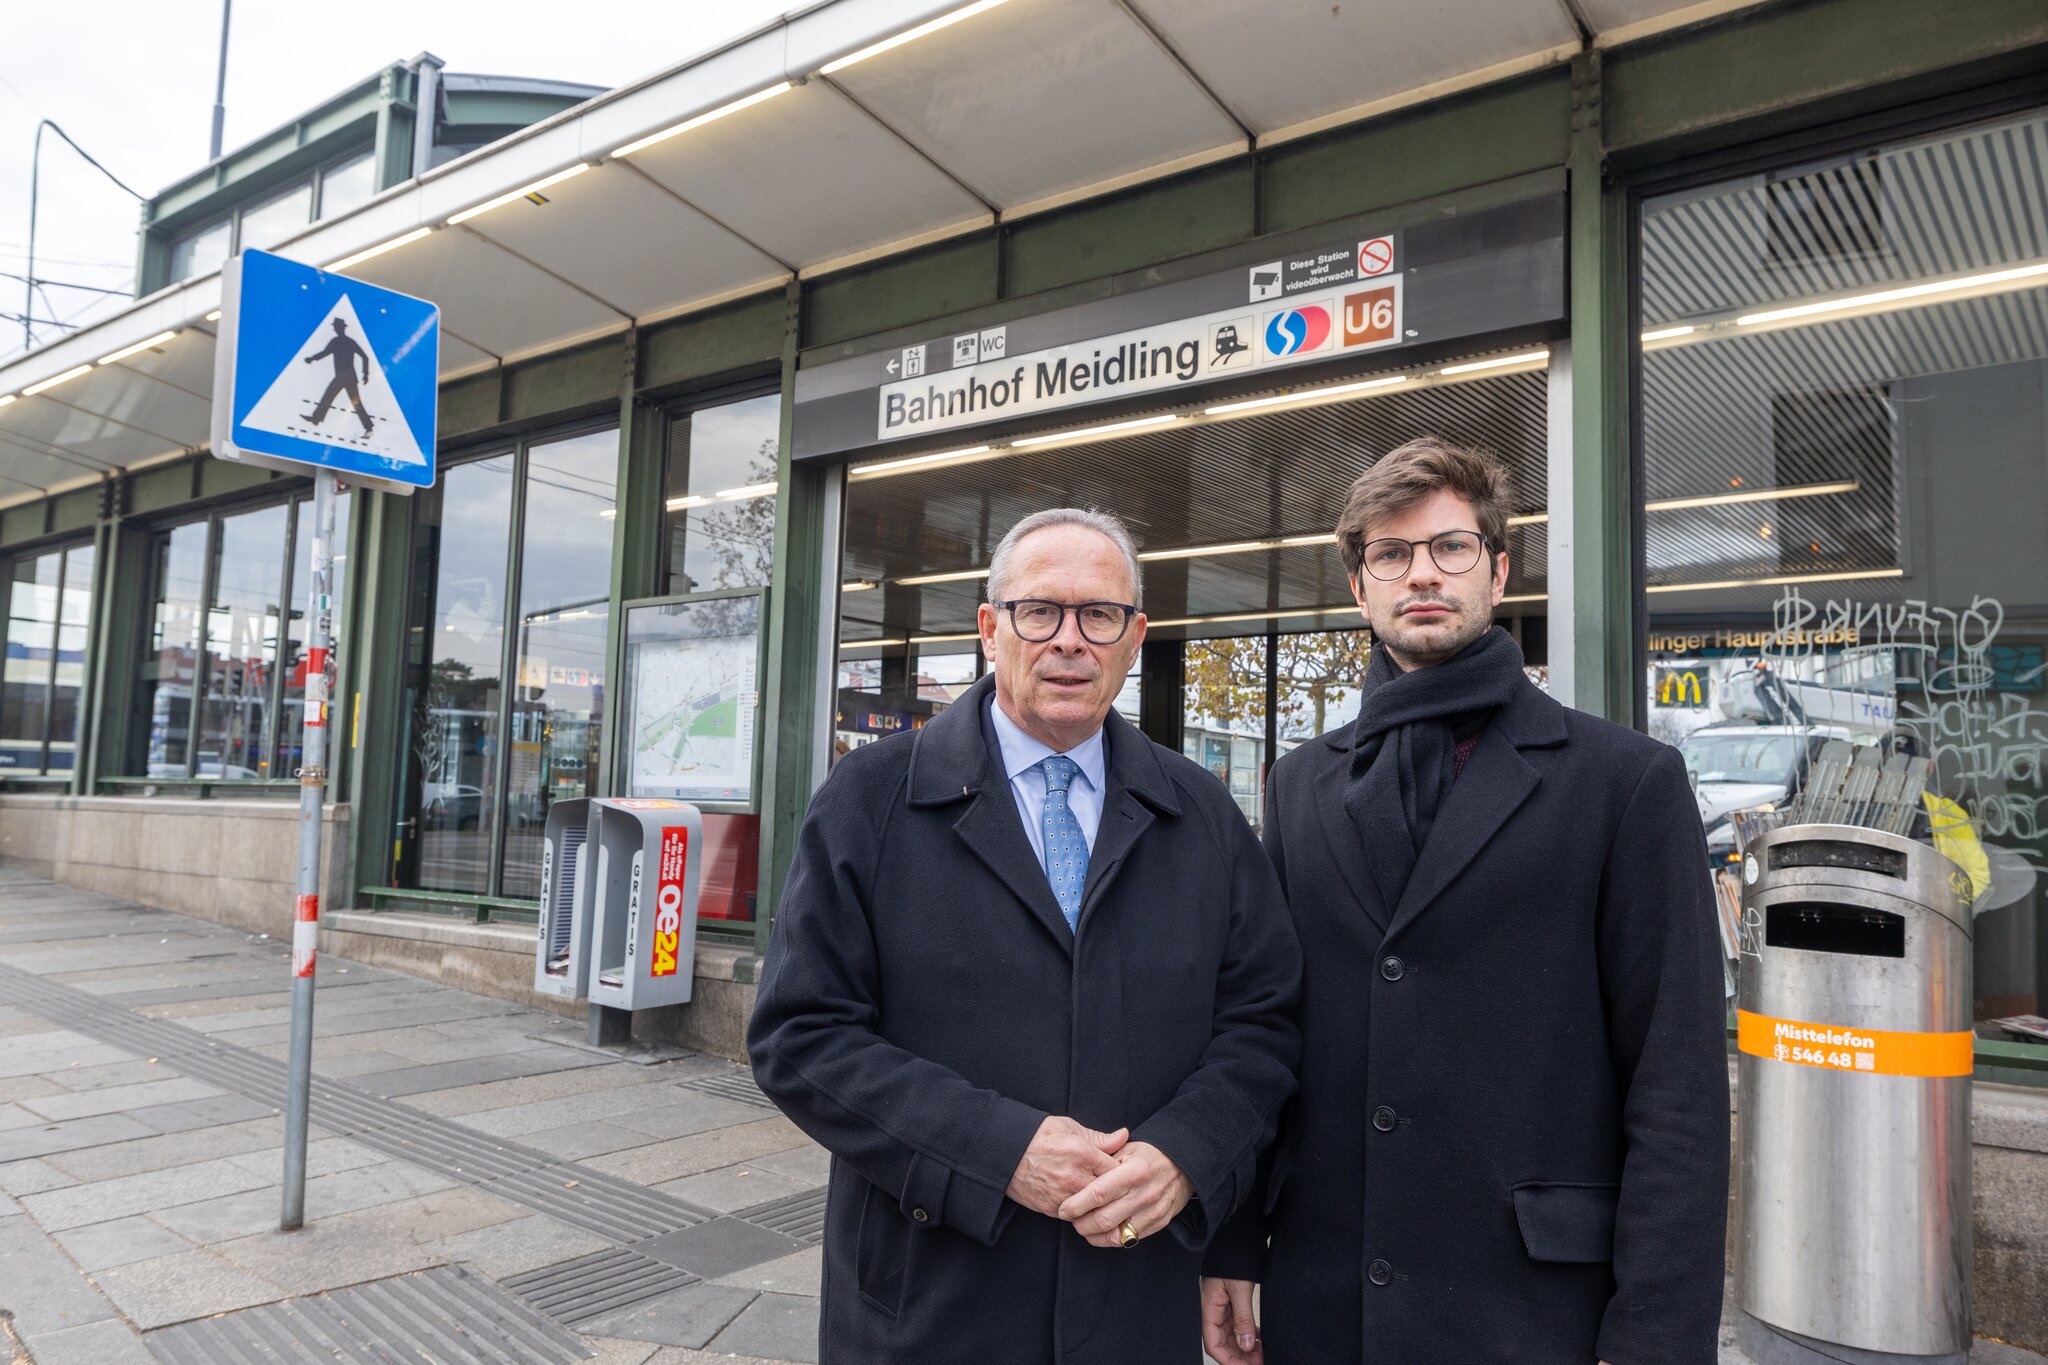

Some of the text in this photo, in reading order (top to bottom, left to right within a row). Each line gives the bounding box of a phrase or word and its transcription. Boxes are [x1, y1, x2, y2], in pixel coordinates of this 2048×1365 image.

[1290, 250, 1350, 271] Diese Station
[1310, 264, 1330, 276] wird
[1285, 268, 1354, 292] videoüberwacht
[1345, 298, 1393, 335] U6
[982, 335, 1005, 352] WC
[886, 338, 1200, 429] Bahnhof Meidling
[539, 852, 552, 941] GRATIS
[628, 863, 641, 957] GRATIS
[1774, 1022, 1875, 1049] Misttelefon
[1791, 1046, 1852, 1068] 546 48
